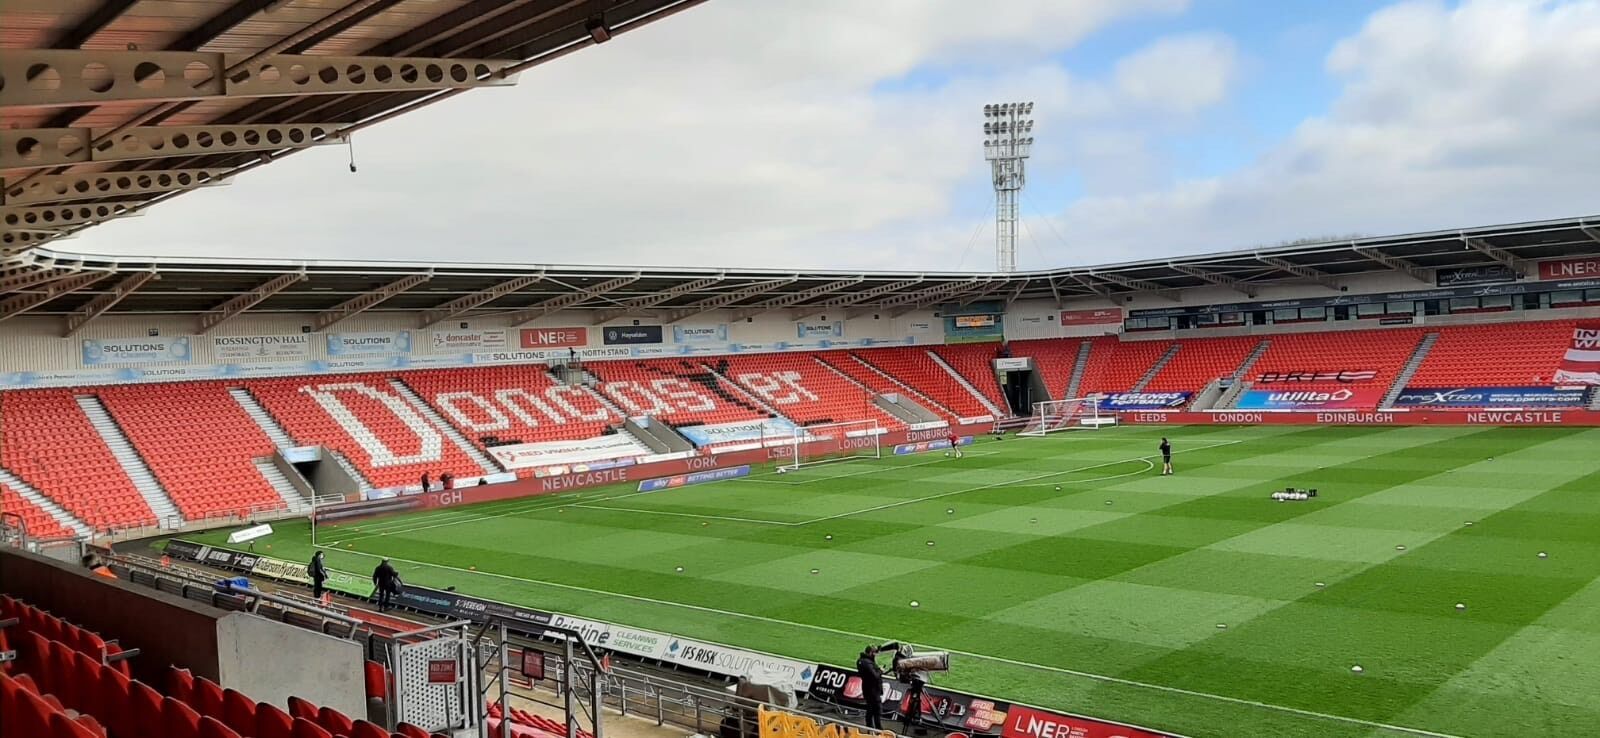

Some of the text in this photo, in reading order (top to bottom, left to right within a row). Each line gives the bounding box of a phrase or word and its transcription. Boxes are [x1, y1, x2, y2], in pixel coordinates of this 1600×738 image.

[1550, 262, 1594, 276] LNER
[215, 335, 307, 346] ROSSINGTON HALL
[343, 337, 391, 345] SOLUTIONS
[446, 333, 481, 342] doncaster
[530, 331, 566, 345] LNER
[103, 344, 165, 353] SOLUTIONS
[582, 348, 606, 357] NORTH
[607, 347, 630, 356] STAND
[475, 354, 492, 362] THE
[493, 352, 546, 361] SOLUTIONS
[142, 369, 186, 377] SOLUTIONS
[1110, 393, 1181, 401] LEGENDS
[1267, 390, 1330, 401] utilita
[1134, 413, 1168, 423] LEEDS
[1212, 413, 1263, 423] LONDON
[1316, 413, 1394, 423] EDINBURGH
[1466, 413, 1562, 423] NEWCASTLE
[704, 424, 768, 436] SOLUTIONS
[906, 428, 953, 442] EDINBURGH
[837, 436, 877, 451] LONDON
[686, 456, 718, 470] YORK
[542, 469, 627, 491] NEWCASTLE
[653, 479, 669, 488] sky
[687, 472, 715, 483] BETTING
[716, 469, 740, 479] BETTER
[617, 631, 658, 645] CLEANING
[613, 639, 655, 654] SERVICES
[681, 645, 697, 660] IFS
[695, 648, 719, 665] RISK
[1014, 714, 1069, 738] LNER
